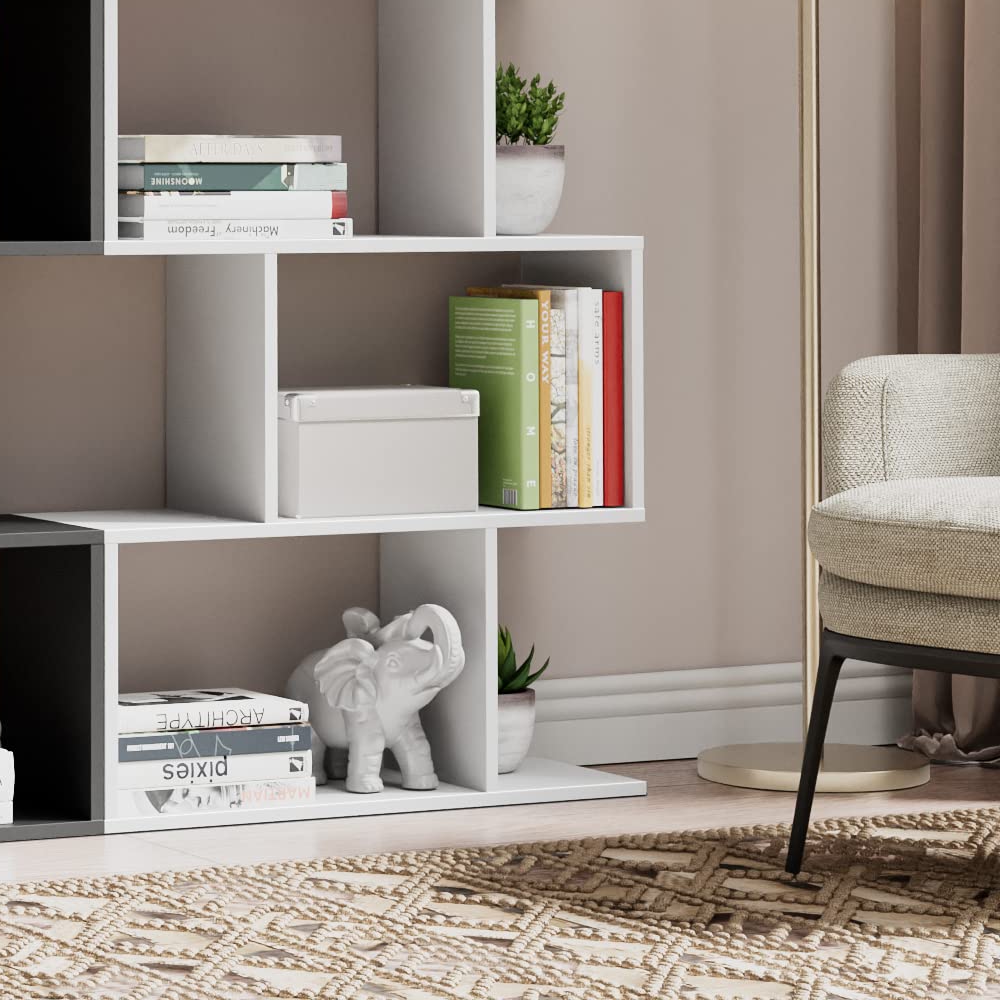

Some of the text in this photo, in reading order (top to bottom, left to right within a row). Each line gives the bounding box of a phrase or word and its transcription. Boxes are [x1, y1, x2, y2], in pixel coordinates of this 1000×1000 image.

[167, 225, 216, 237] Freedom
[225, 223, 279, 236] Machinery
[541, 300, 550, 385] YOUR WAY
[155, 708, 264, 729] ARCHITYPE
[162, 755, 228, 783] pixies
[240, 786, 310, 802] MARTIAN
